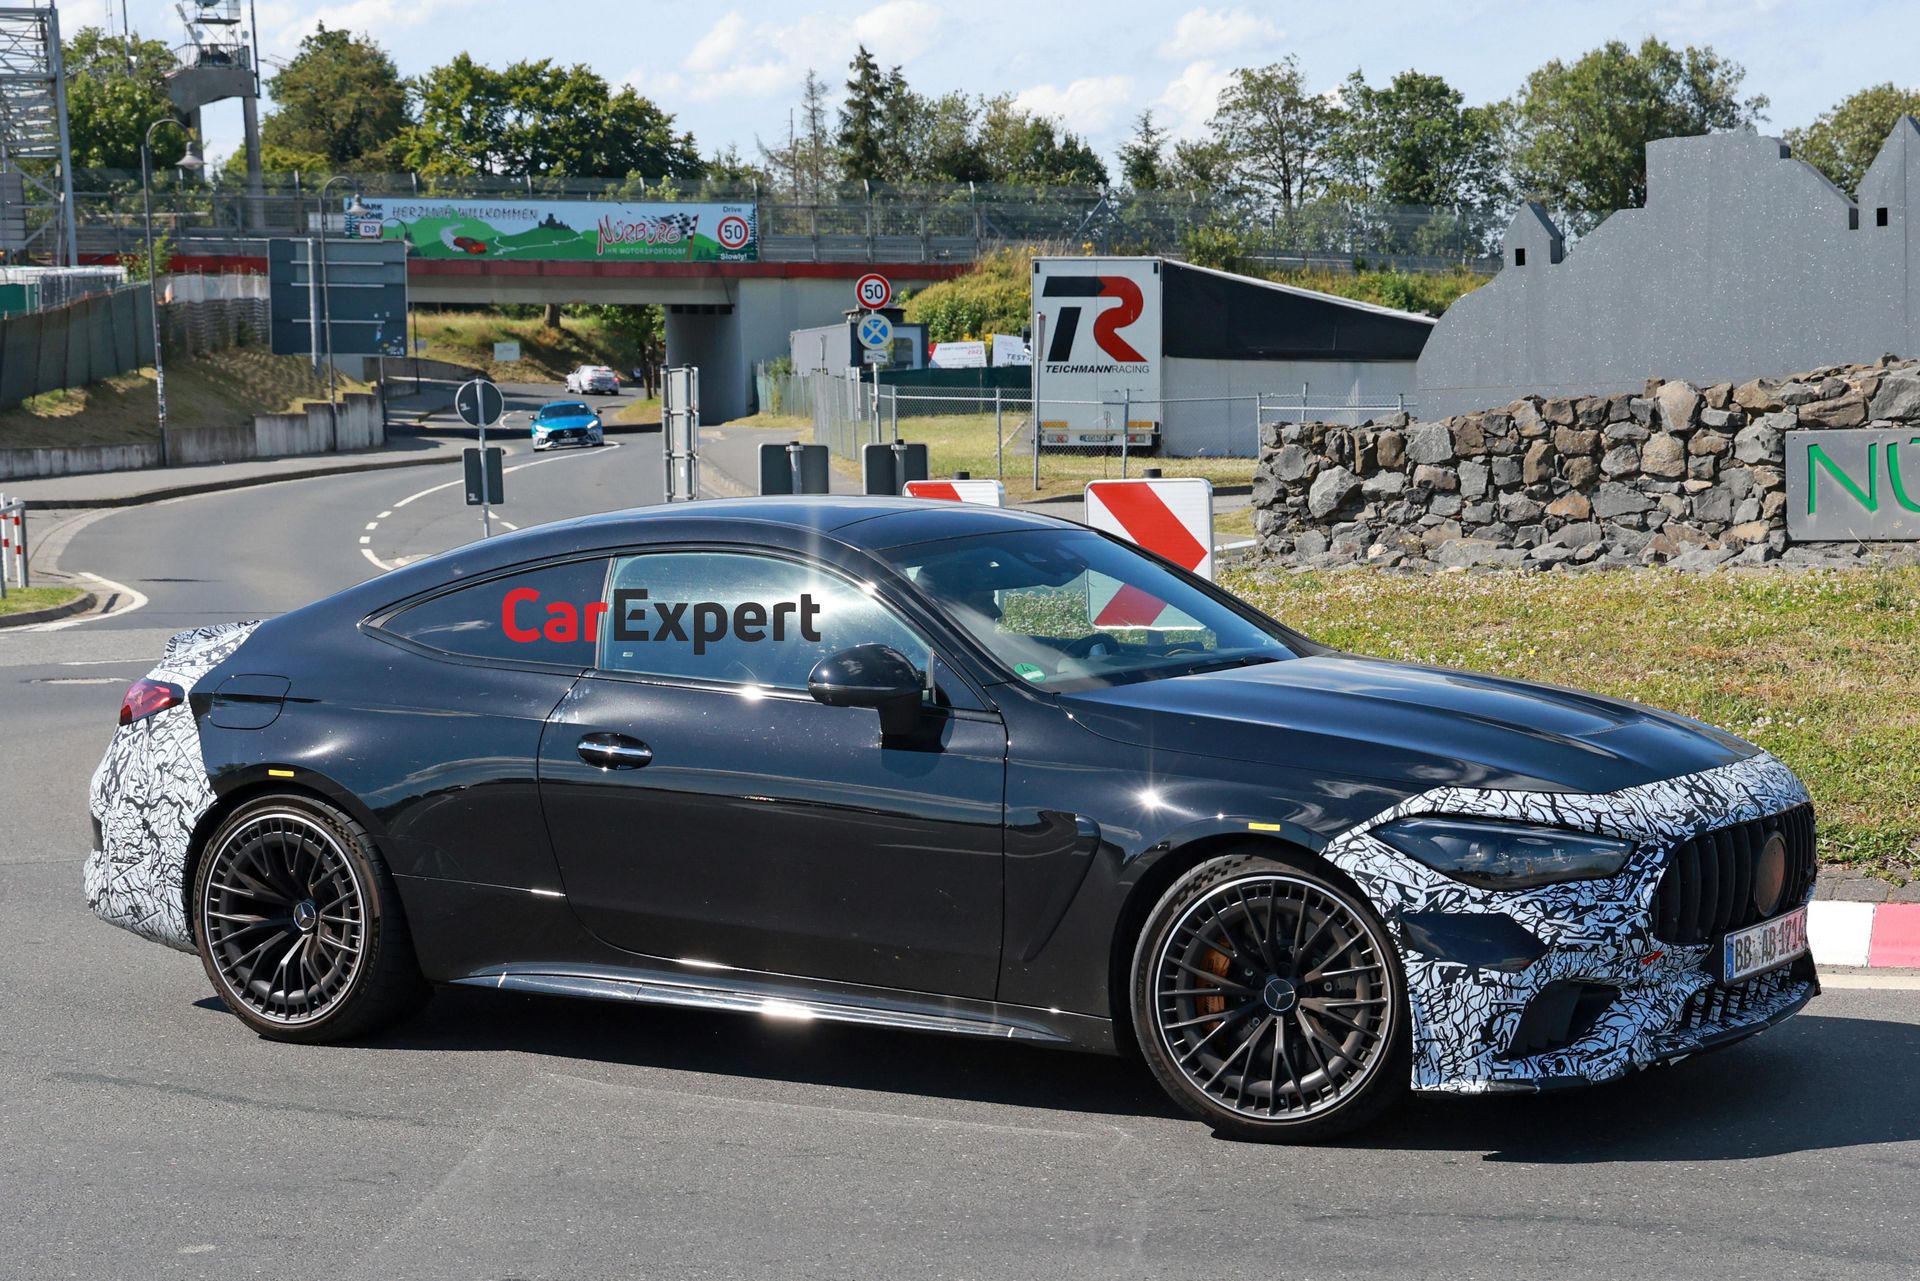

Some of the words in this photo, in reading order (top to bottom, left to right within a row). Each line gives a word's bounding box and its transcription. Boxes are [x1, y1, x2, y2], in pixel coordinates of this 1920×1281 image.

[458, 207, 538, 219] WILLKOMMEN
[724, 225, 743, 240] 50
[720, 252, 748, 261] Slowly!
[864, 284, 884, 300] 50
[1020, 663, 1032, 672] 4
[1735, 934, 1752, 974] BB
[1761, 926, 1777, 964] AB
